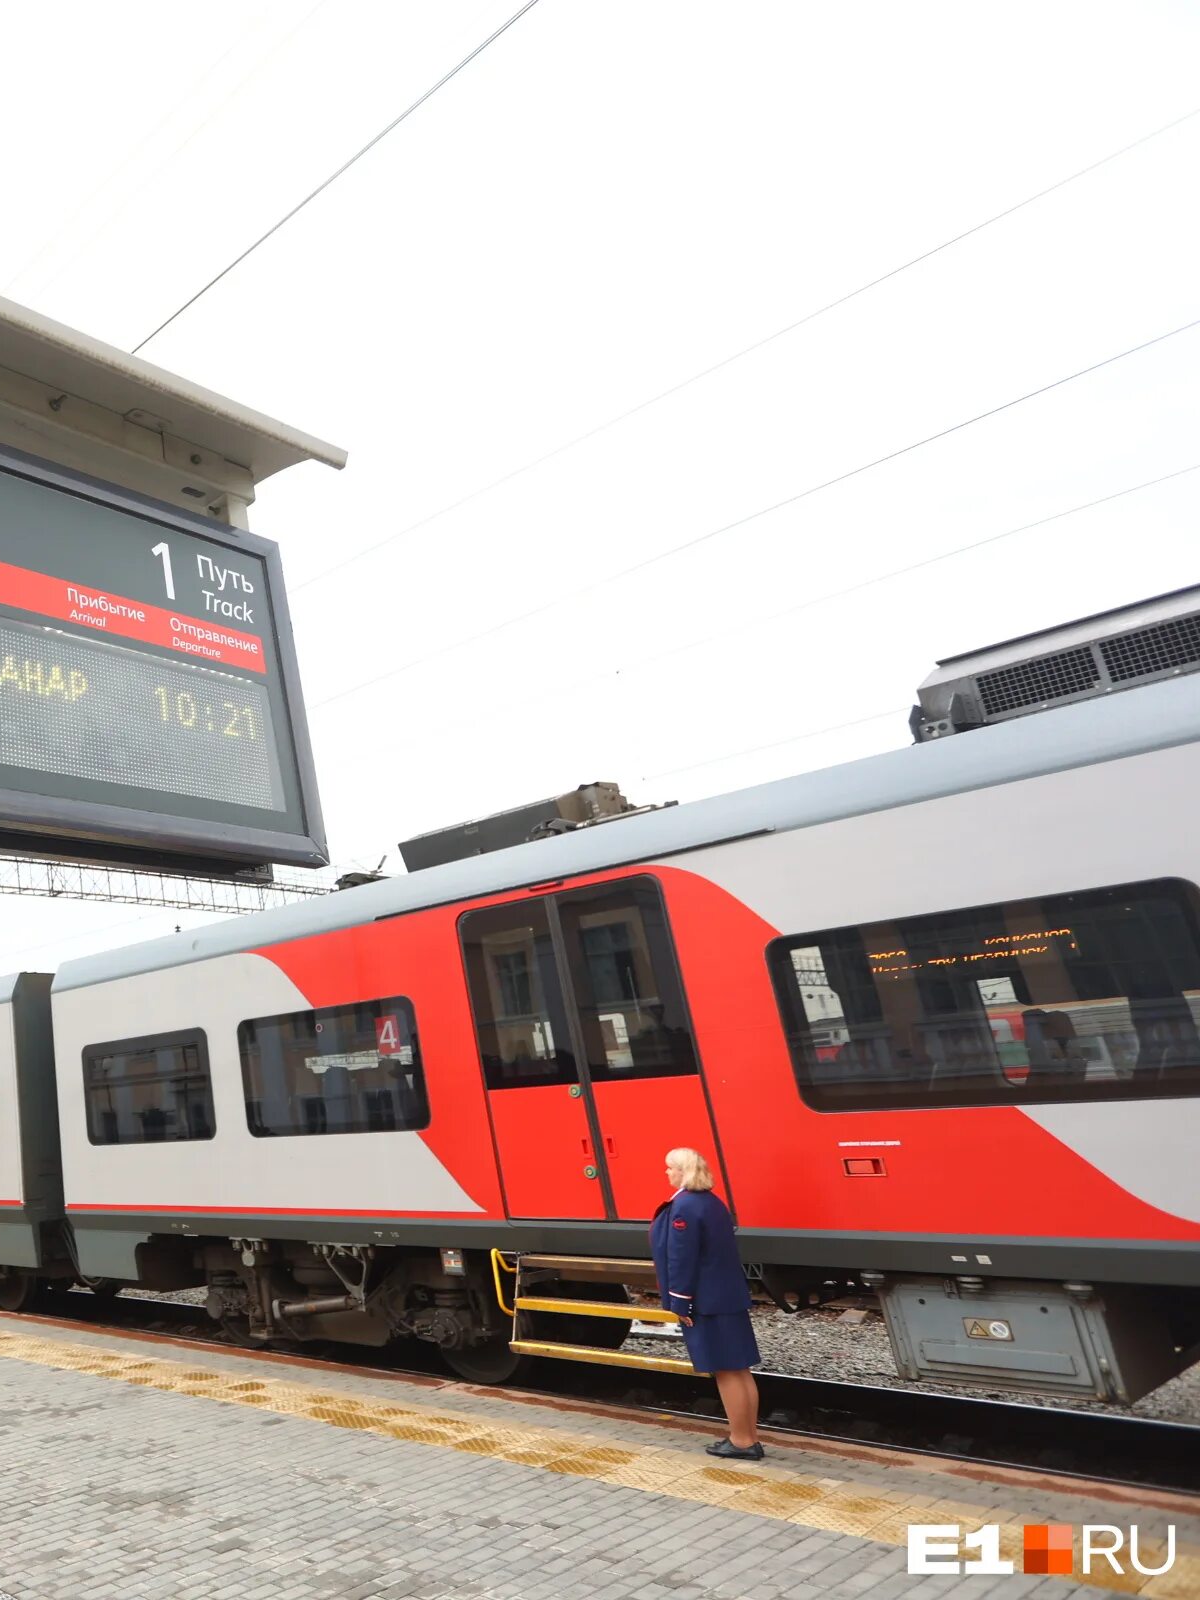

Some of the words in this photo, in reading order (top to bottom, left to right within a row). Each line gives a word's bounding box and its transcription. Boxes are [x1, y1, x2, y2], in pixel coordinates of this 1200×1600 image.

[151, 541, 176, 600] 1
[196, 554, 254, 594] Путь
[67, 587, 145, 622] Прибытие
[69, 609, 106, 628] Arrival
[202, 590, 254, 624] Track
[170, 617, 258, 654] Отправление
[172, 637, 221, 659] Departure
[154, 687, 255, 740] 10:21
[379, 1020, 398, 1049] 4
